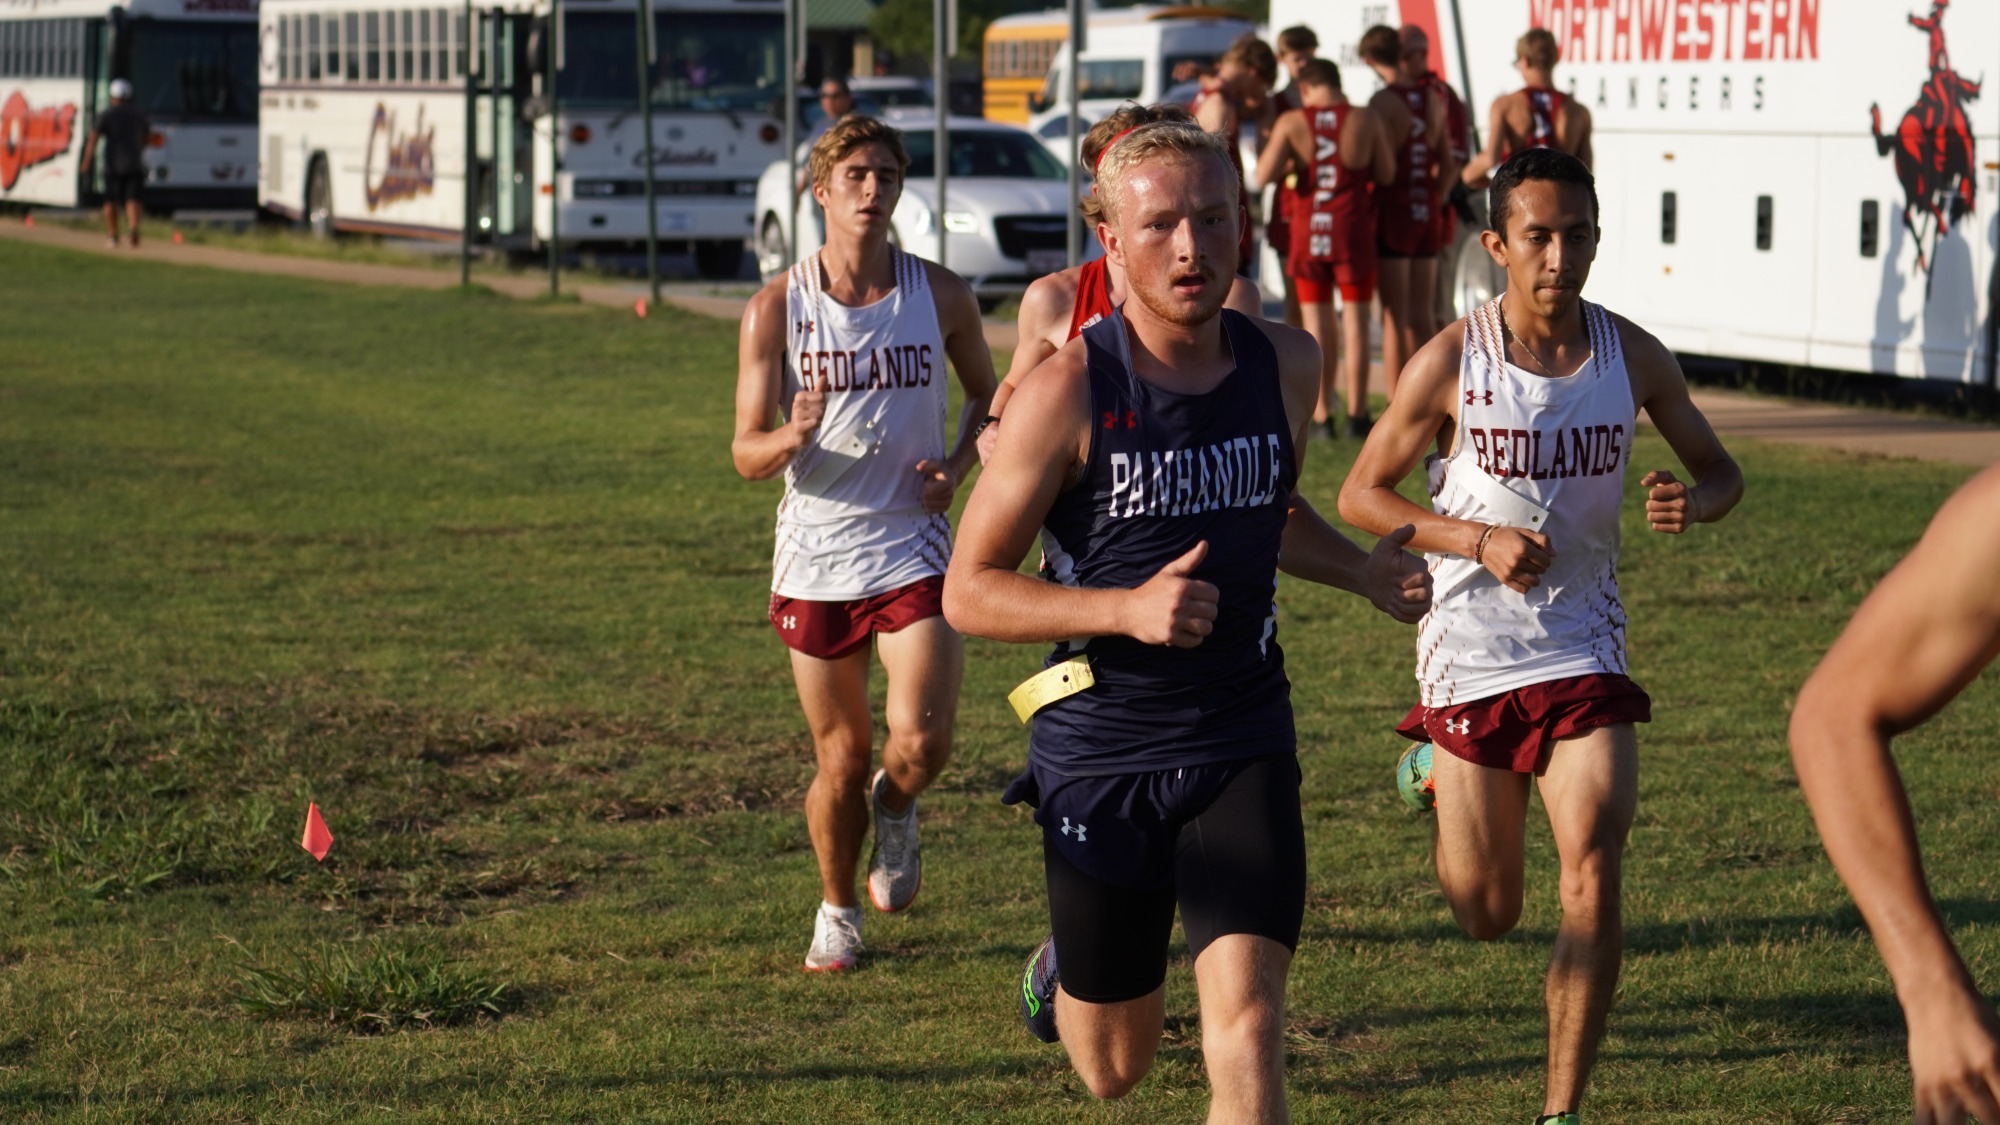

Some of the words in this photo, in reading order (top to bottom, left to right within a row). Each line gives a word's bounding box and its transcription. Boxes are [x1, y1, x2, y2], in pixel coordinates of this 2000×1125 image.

[1310, 110, 1338, 257] EAGLES
[800, 344, 932, 393] REDLANDS
[1108, 433, 1280, 518] PANHANDLE
[1469, 424, 1624, 481] REDLANDS
